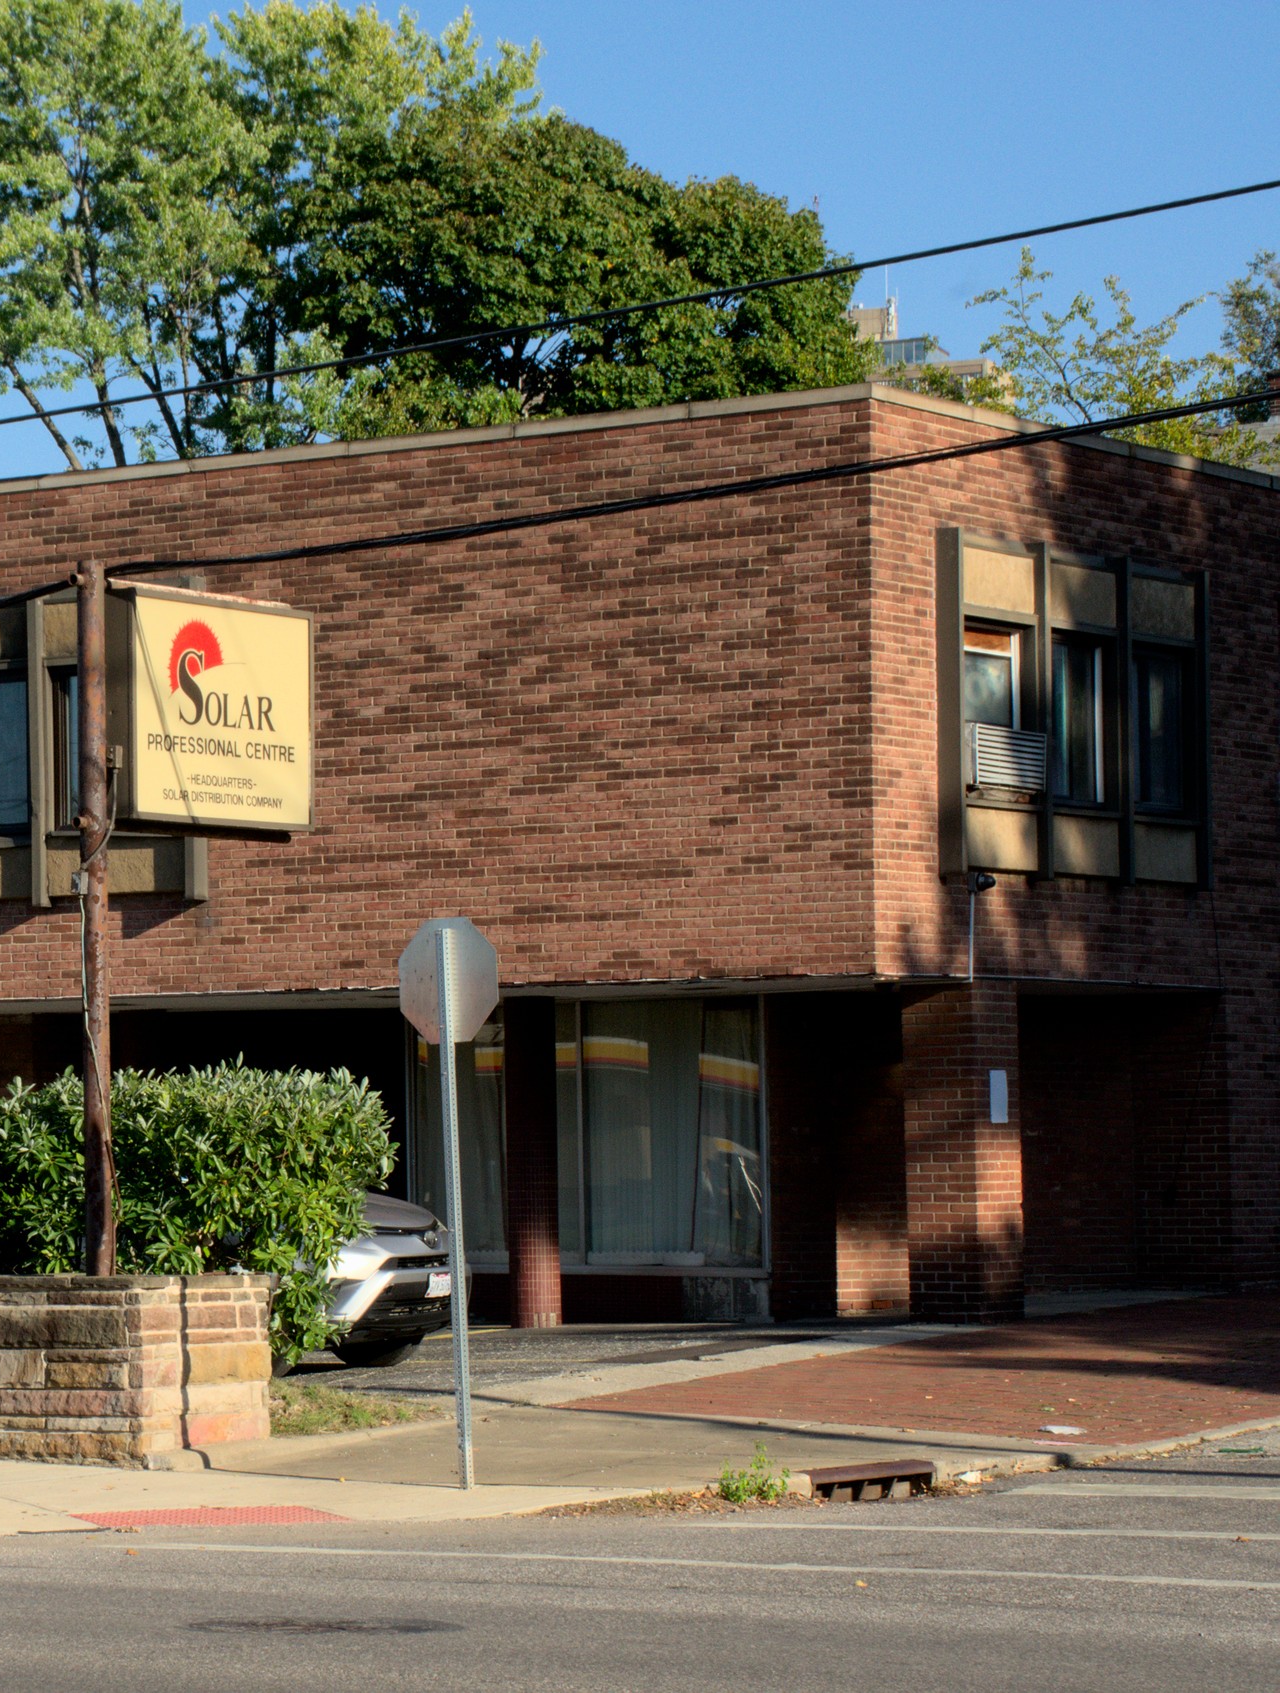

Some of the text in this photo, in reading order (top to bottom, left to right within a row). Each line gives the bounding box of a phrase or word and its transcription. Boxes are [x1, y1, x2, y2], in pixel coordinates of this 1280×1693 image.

[179, 650, 276, 732] SOLAR
[147, 733, 295, 763] PROFESSIONAL CENTRE
[162, 788, 283, 809] SOLAR DISTRIBUTION COMPANY
